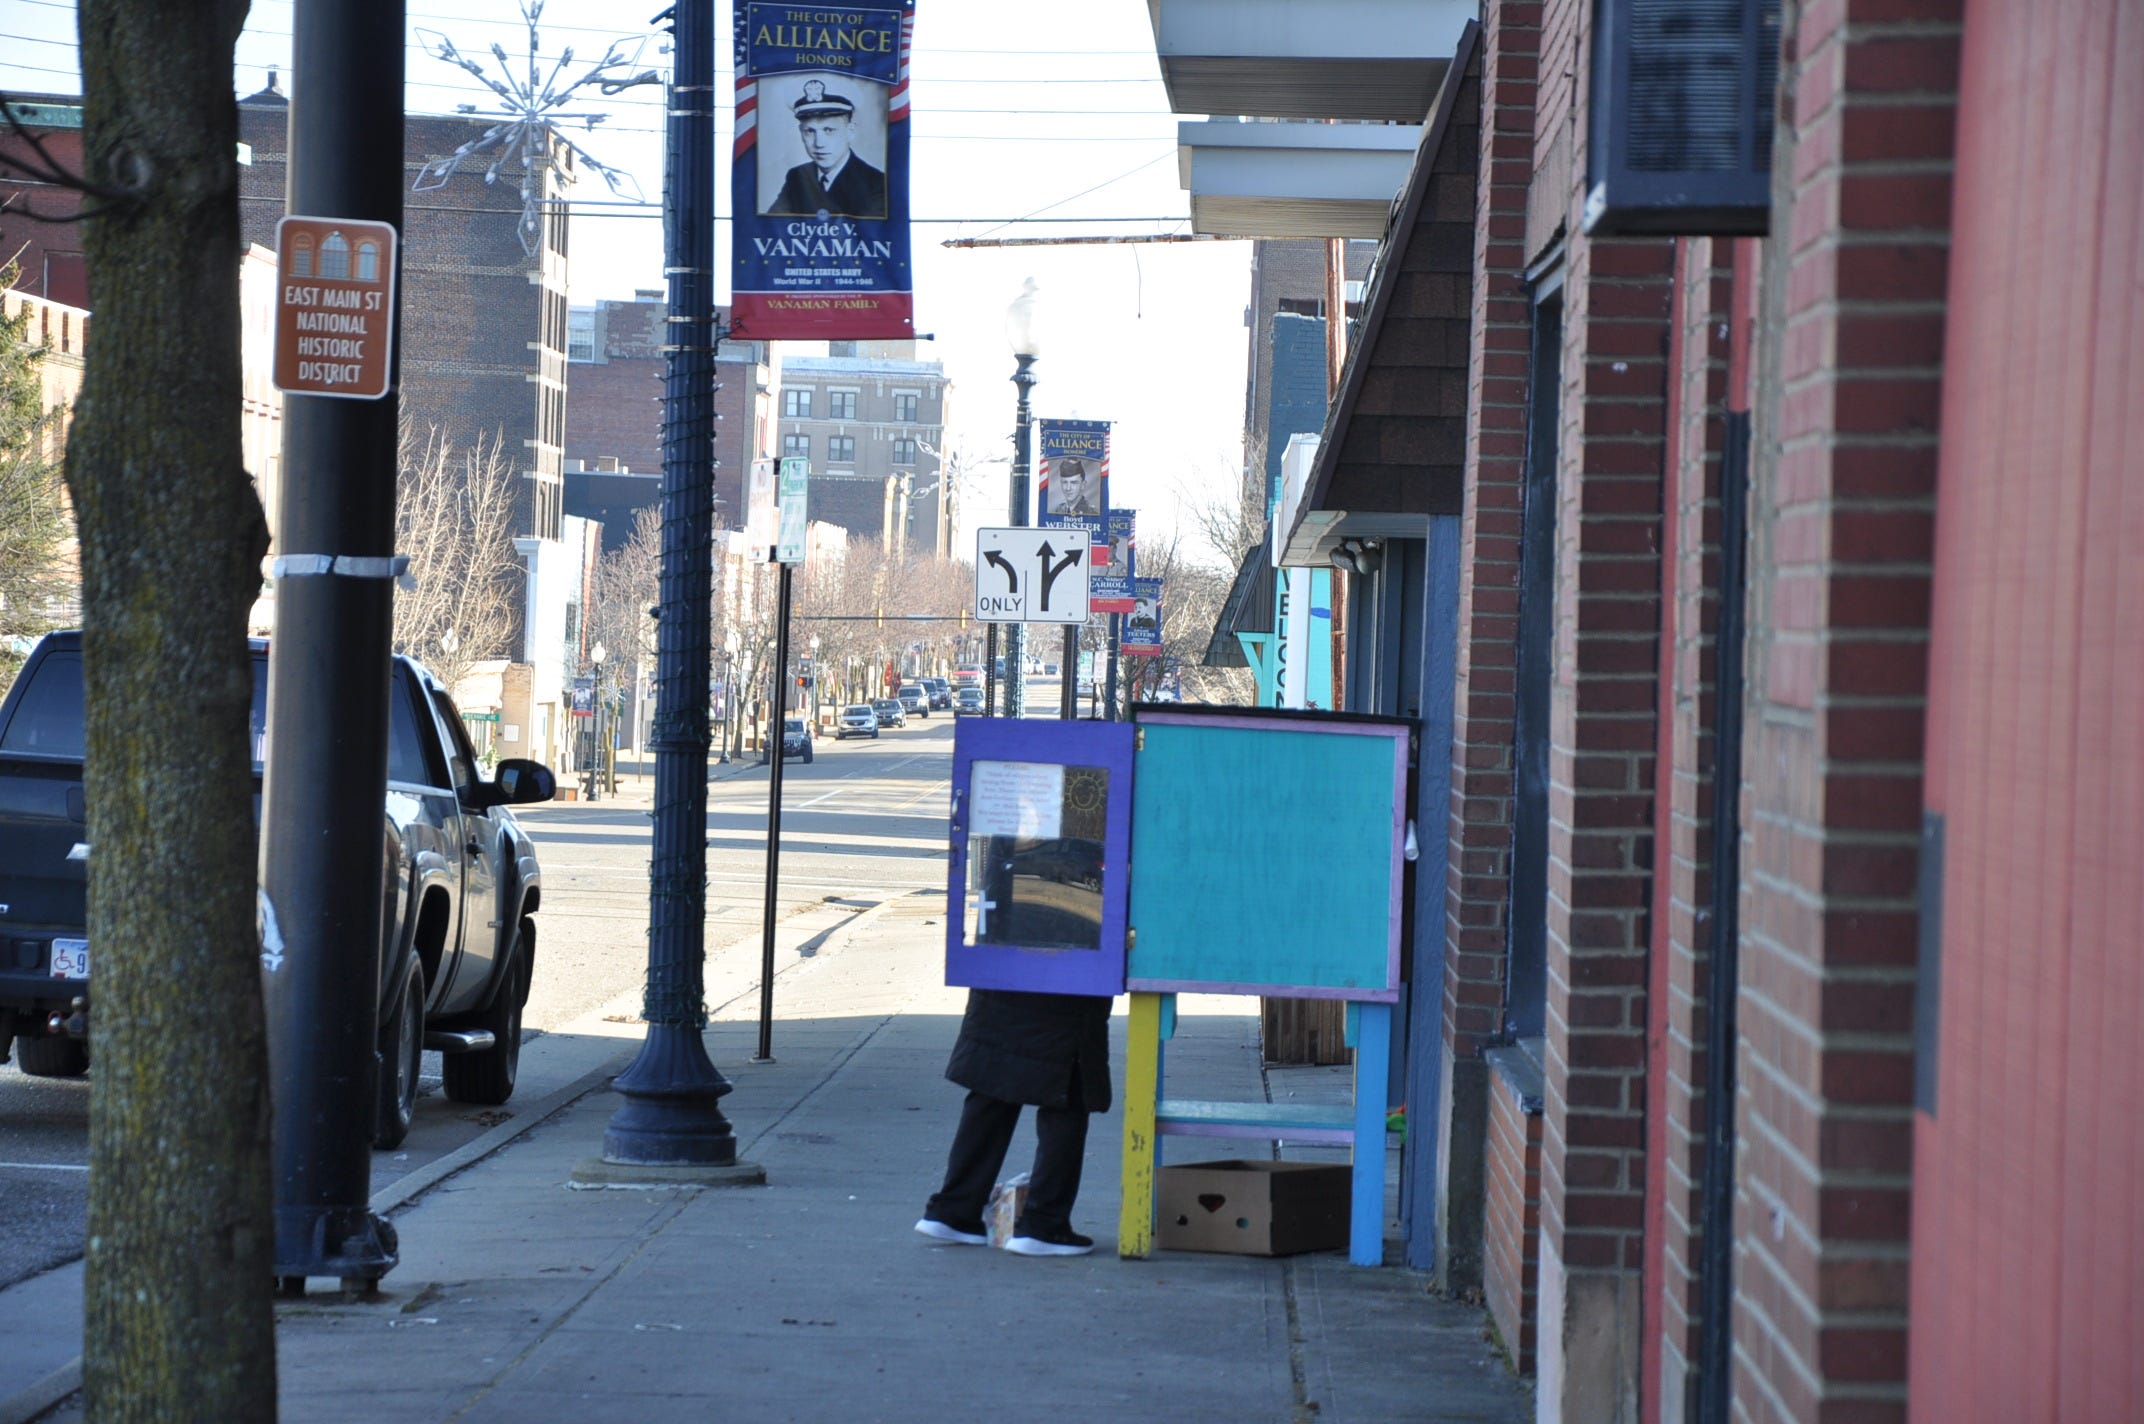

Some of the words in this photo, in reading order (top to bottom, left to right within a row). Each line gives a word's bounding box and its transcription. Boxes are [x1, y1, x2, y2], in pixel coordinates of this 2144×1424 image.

[785, 10, 812, 23] THE
[814, 12, 844, 25] CITY
[847, 14, 864, 25] OF
[755, 24, 892, 52] ALLIANCE
[796, 53, 852, 66] HONORS
[787, 222, 840, 241] Clyde
[842, 223, 858, 237] V.
[752, 237, 892, 259] VANAMAN
[784, 268, 812, 276] UNITED
[813, 268, 841, 276] STATES
[285, 286, 320, 306] EAST
[322, 288, 361, 309] MAIN
[365, 291, 383, 311] ST
[767, 299, 831, 309] VANAMAN
[834, 299, 879, 309] FAMILY
[297, 311, 368, 335] NATIONAL
[298, 336, 364, 359] HISTORIC
[298, 361, 362, 384] DISTRICT
[1047, 438, 1102, 450] ALLIANCE
[1045, 521, 1101, 532] WEBSTER
[1063, 515, 1083, 523] Boyd
[980, 597, 1022, 612] ONLY
